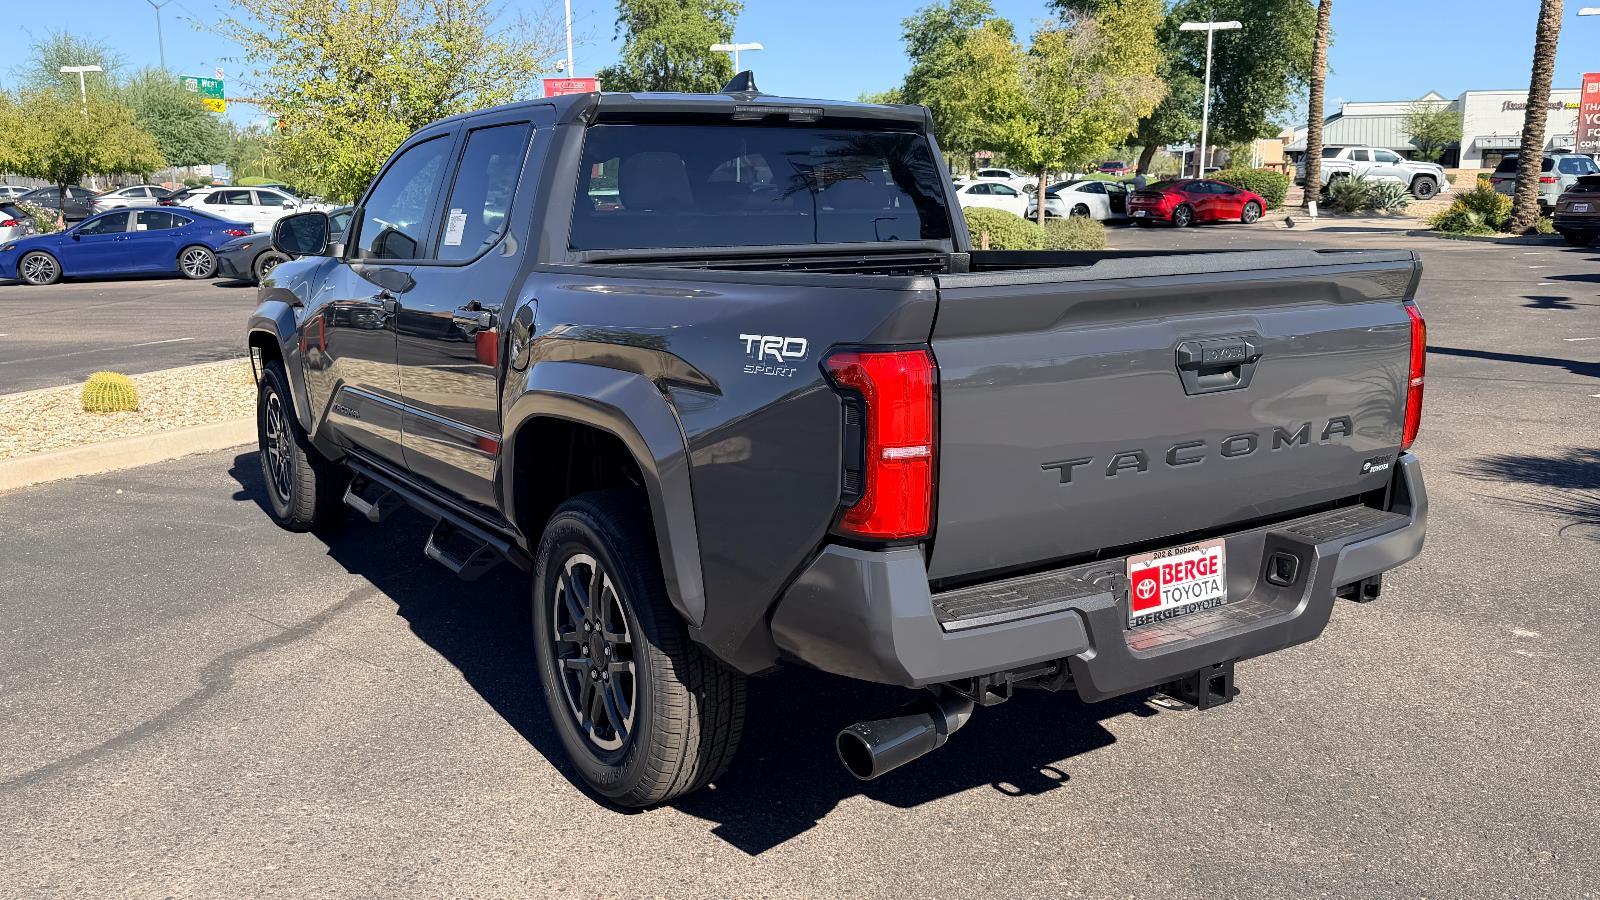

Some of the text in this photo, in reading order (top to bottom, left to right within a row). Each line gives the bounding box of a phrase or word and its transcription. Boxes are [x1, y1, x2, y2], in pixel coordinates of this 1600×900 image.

[739, 333, 807, 362] TRD
[1205, 346, 1245, 361] TOYOTA
[743, 364, 797, 377] SPORT
[1041, 415, 1355, 484] TACOMA
[1153, 551, 1166, 560] 202
[1174, 545, 1200, 555] Dobson
[1162, 555, 1218, 585] BERGE
[1163, 579, 1220, 604] TOYOTA
[1135, 597, 1222, 626] BERGE TOYOTA
